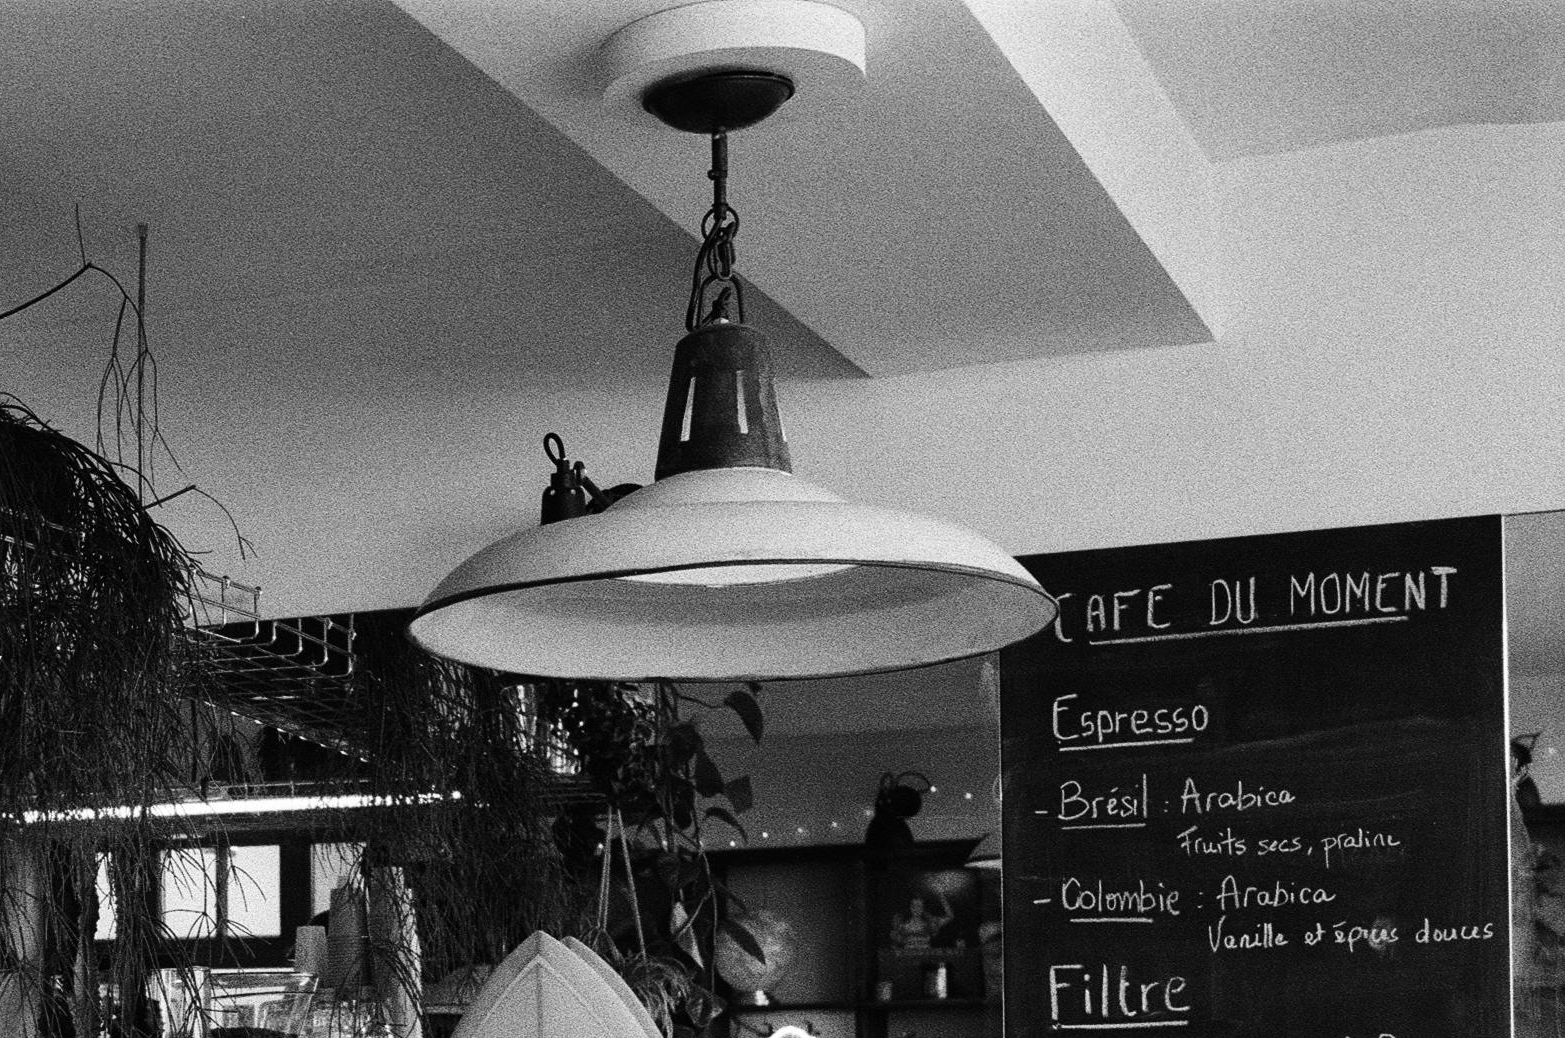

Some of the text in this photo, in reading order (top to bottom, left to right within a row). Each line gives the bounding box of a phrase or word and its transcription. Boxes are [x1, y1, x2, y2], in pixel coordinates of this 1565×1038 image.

[1053, 566, 1458, 643] CAFE DU MOMENT
[1052, 693, 1209, 742] Espresso
[1181, 778, 1296, 815] Arabica
[1177, 826, 1247, 856] Fruits
[1061, 877, 1181, 916] Colombie
[1216, 875, 1337, 910] Arabica
[1208, 916, 1289, 953] Vanille
[1304, 922, 1326, 945] et
[1415, 917, 1495, 944] douces
[1048, 964, 1191, 1021] Filtre
